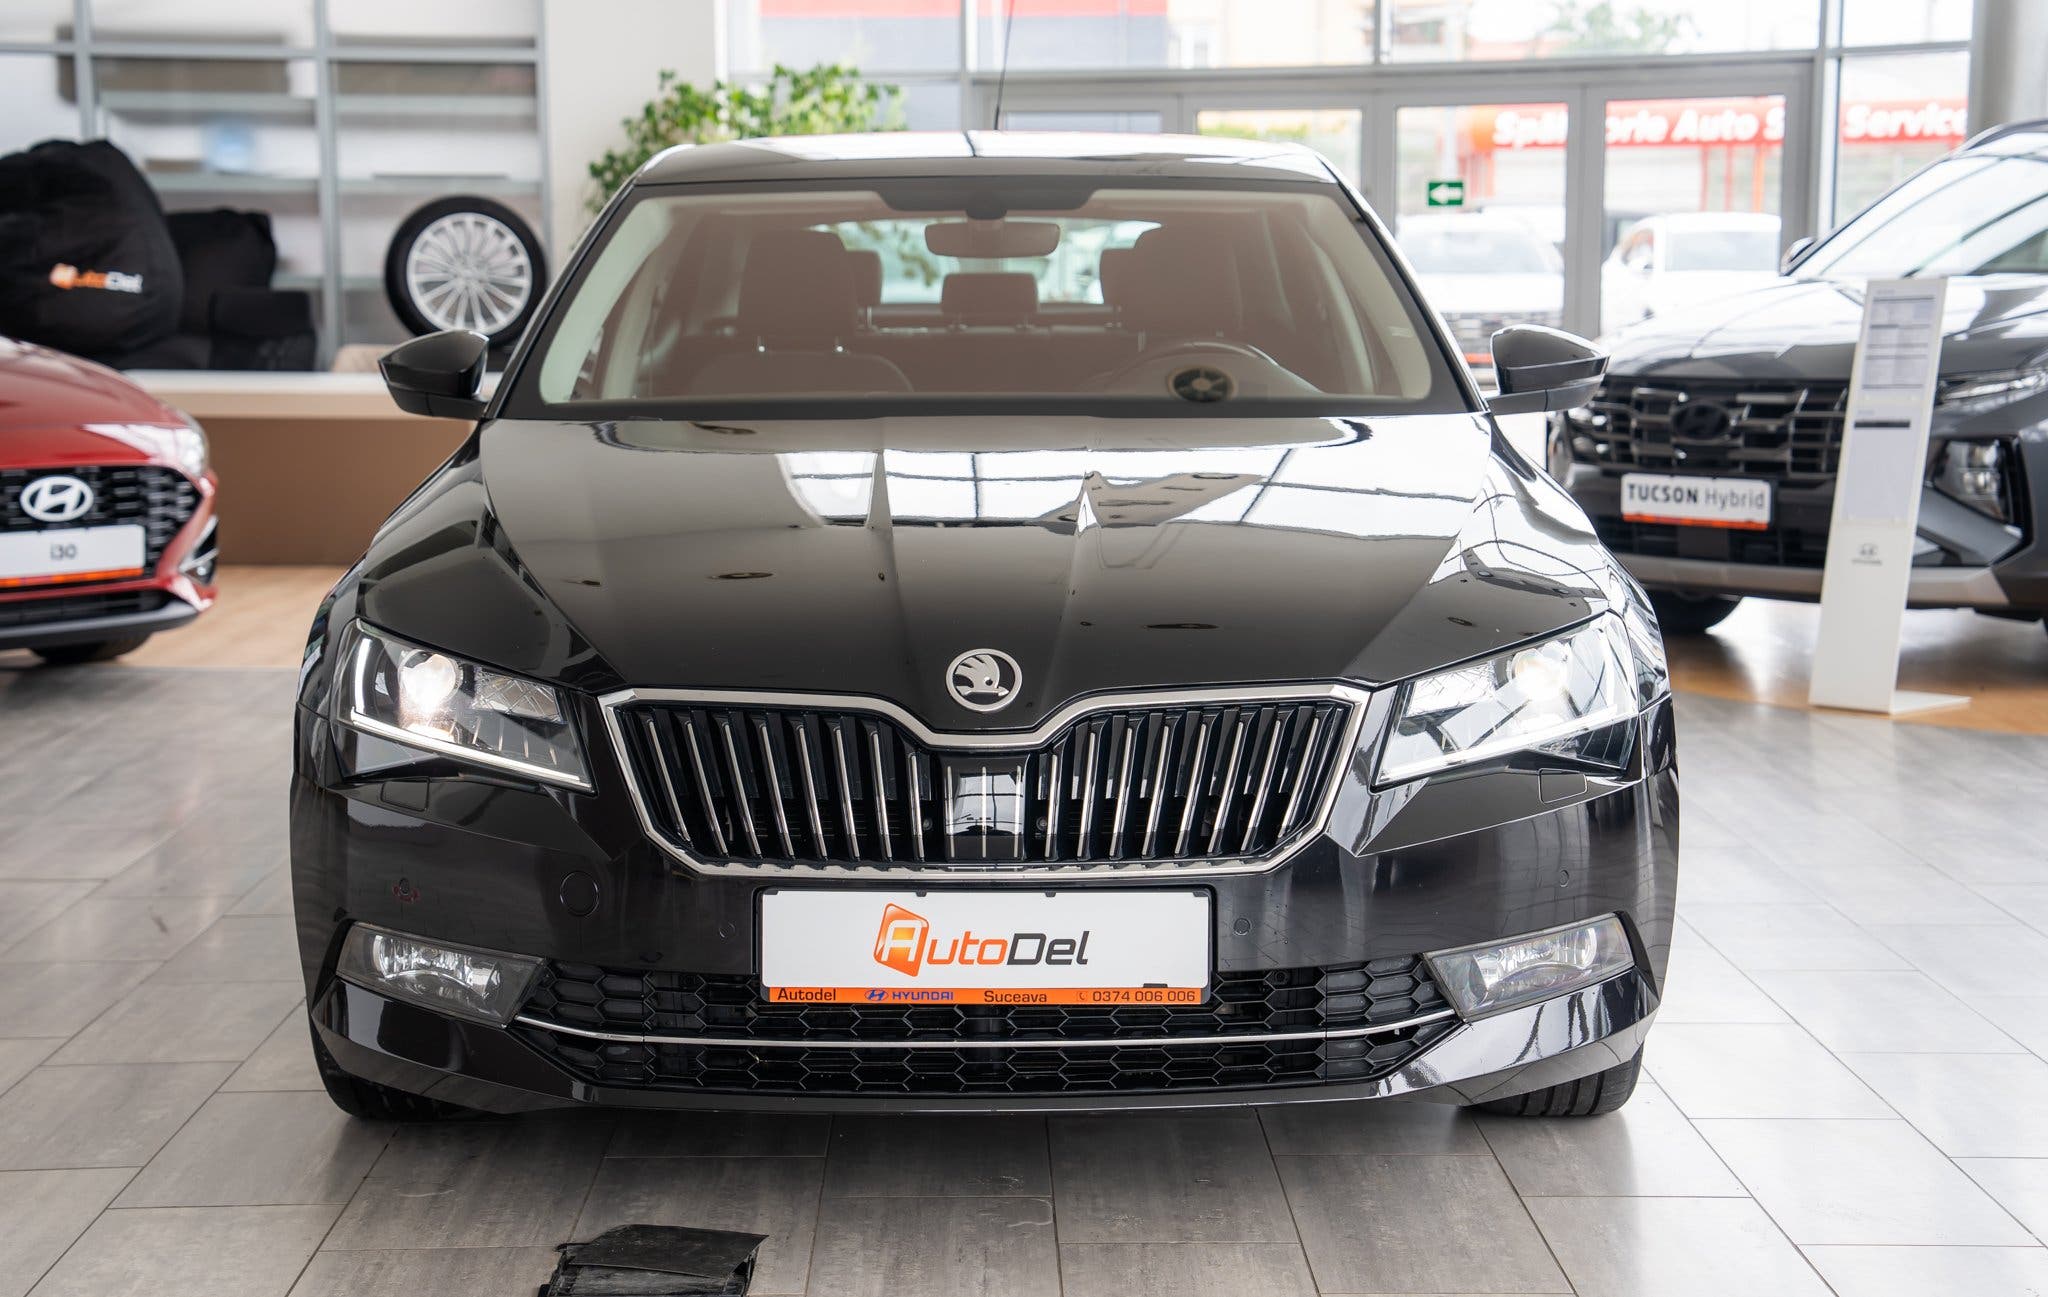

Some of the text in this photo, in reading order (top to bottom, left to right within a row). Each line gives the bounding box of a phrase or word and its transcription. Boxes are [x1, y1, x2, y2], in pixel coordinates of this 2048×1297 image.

[1671, 108, 1759, 143] Auto
[1627, 483, 1764, 511] TUCSON Hybrid
[50, 543, 77, 560] i30
[874, 907, 1089, 970] AutoDel
[777, 988, 1196, 1003] Autodel HYUNDAI Suceava 0374 006 006
